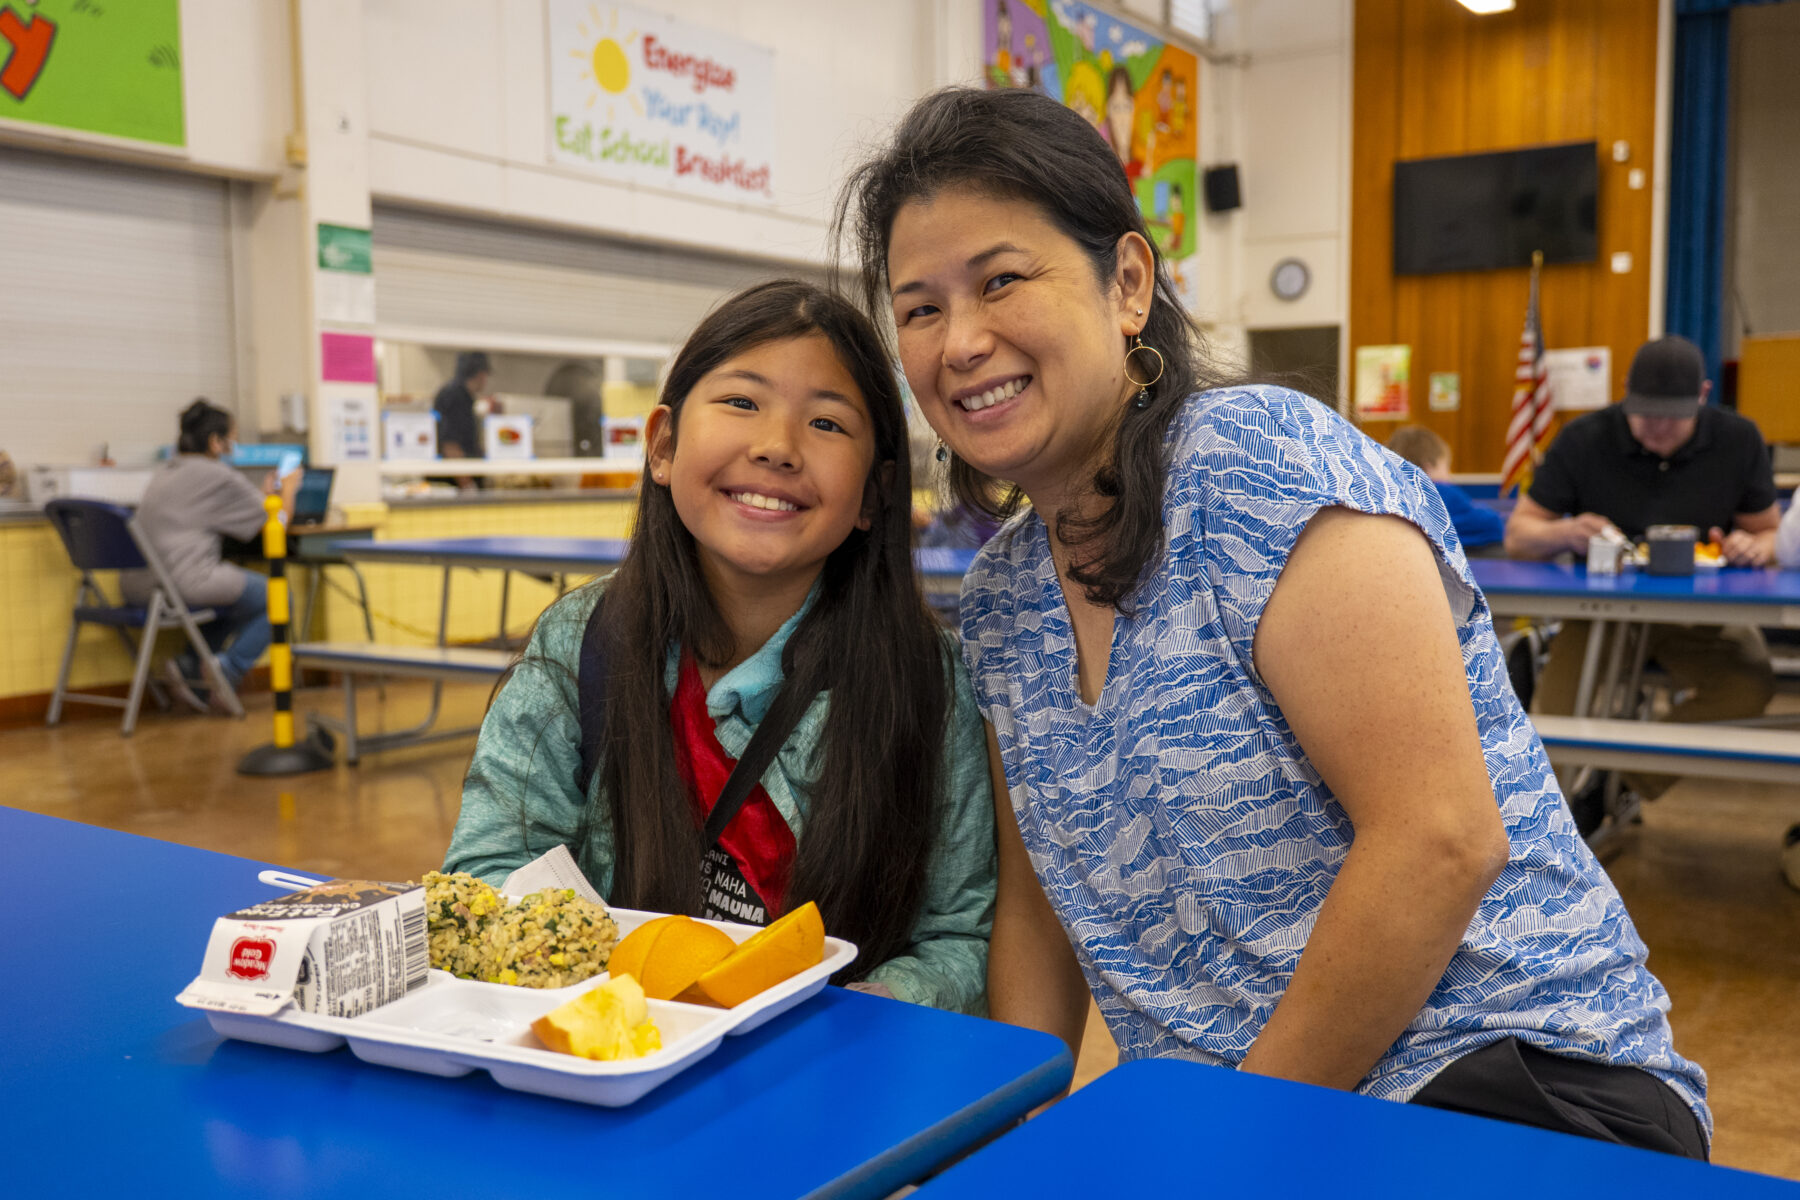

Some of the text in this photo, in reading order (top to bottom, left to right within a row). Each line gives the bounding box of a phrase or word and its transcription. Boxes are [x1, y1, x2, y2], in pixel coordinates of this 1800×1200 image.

[600, 127, 670, 169] School
[714, 870, 747, 898] NAHA
[708, 888, 764, 924] MAUNA
[233, 948, 268, 971] Meadow Gold
